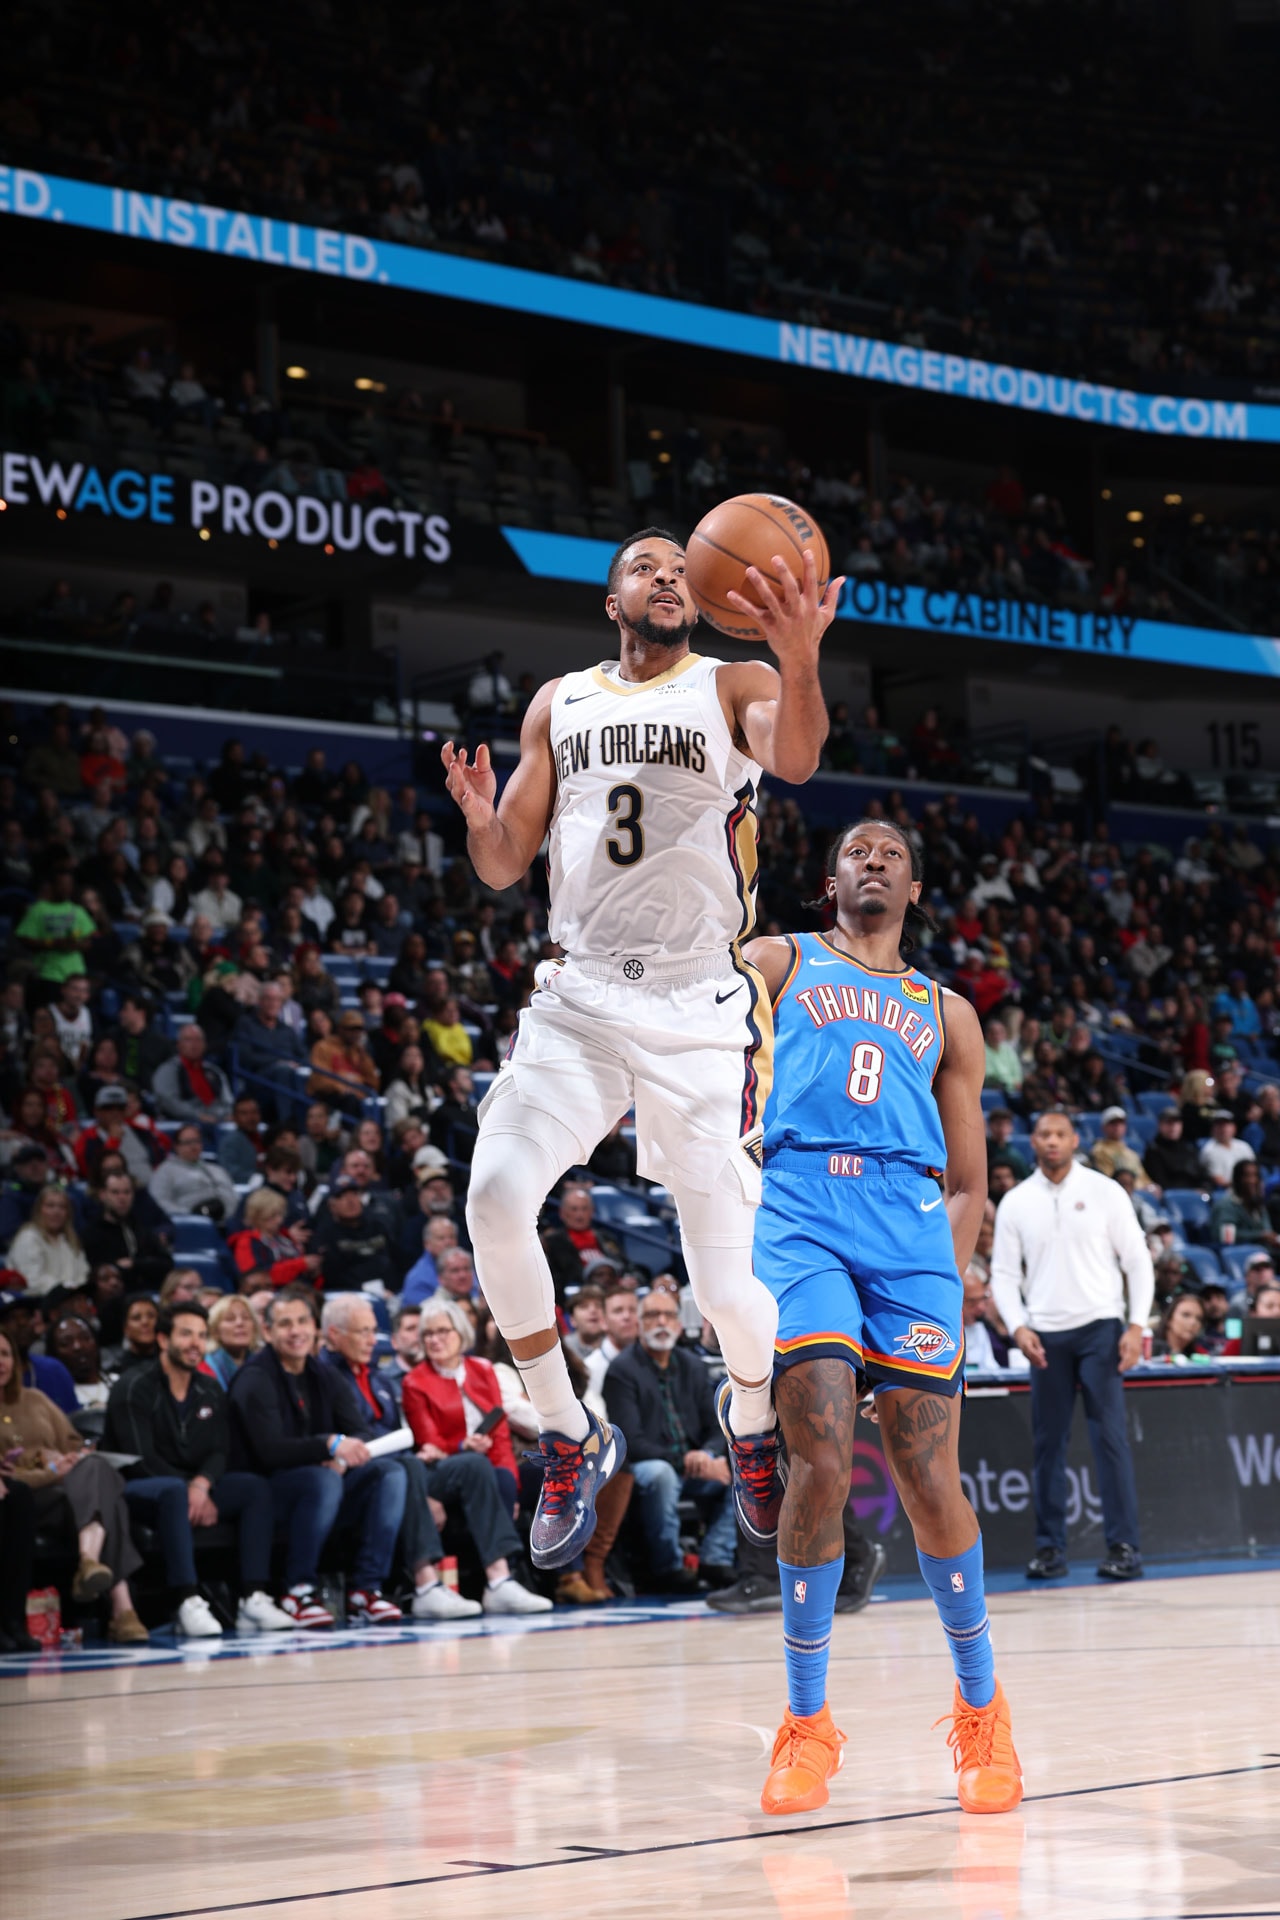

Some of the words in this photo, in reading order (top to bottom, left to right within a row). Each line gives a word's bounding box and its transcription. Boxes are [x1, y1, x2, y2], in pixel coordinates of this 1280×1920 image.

[112, 187, 389, 284] INSTALLED.
[779, 321, 1248, 440] NEWAGEPRODUCTS.COM
[2, 452, 174, 525] EWAGE
[191, 480, 451, 563] PRODUCTS
[922, 591, 1138, 652] CABINETRY
[600, 723, 706, 774] ORLEANS
[1206, 721, 1262, 770] 115
[605, 781, 646, 868] 3
[796, 984, 935, 1062] THUNDER
[846, 1040, 885, 1105] 8
[828, 1154, 863, 1177] OKC
[904, 1333, 944, 1349] OKC
[1227, 1432, 1280, 1487] W
